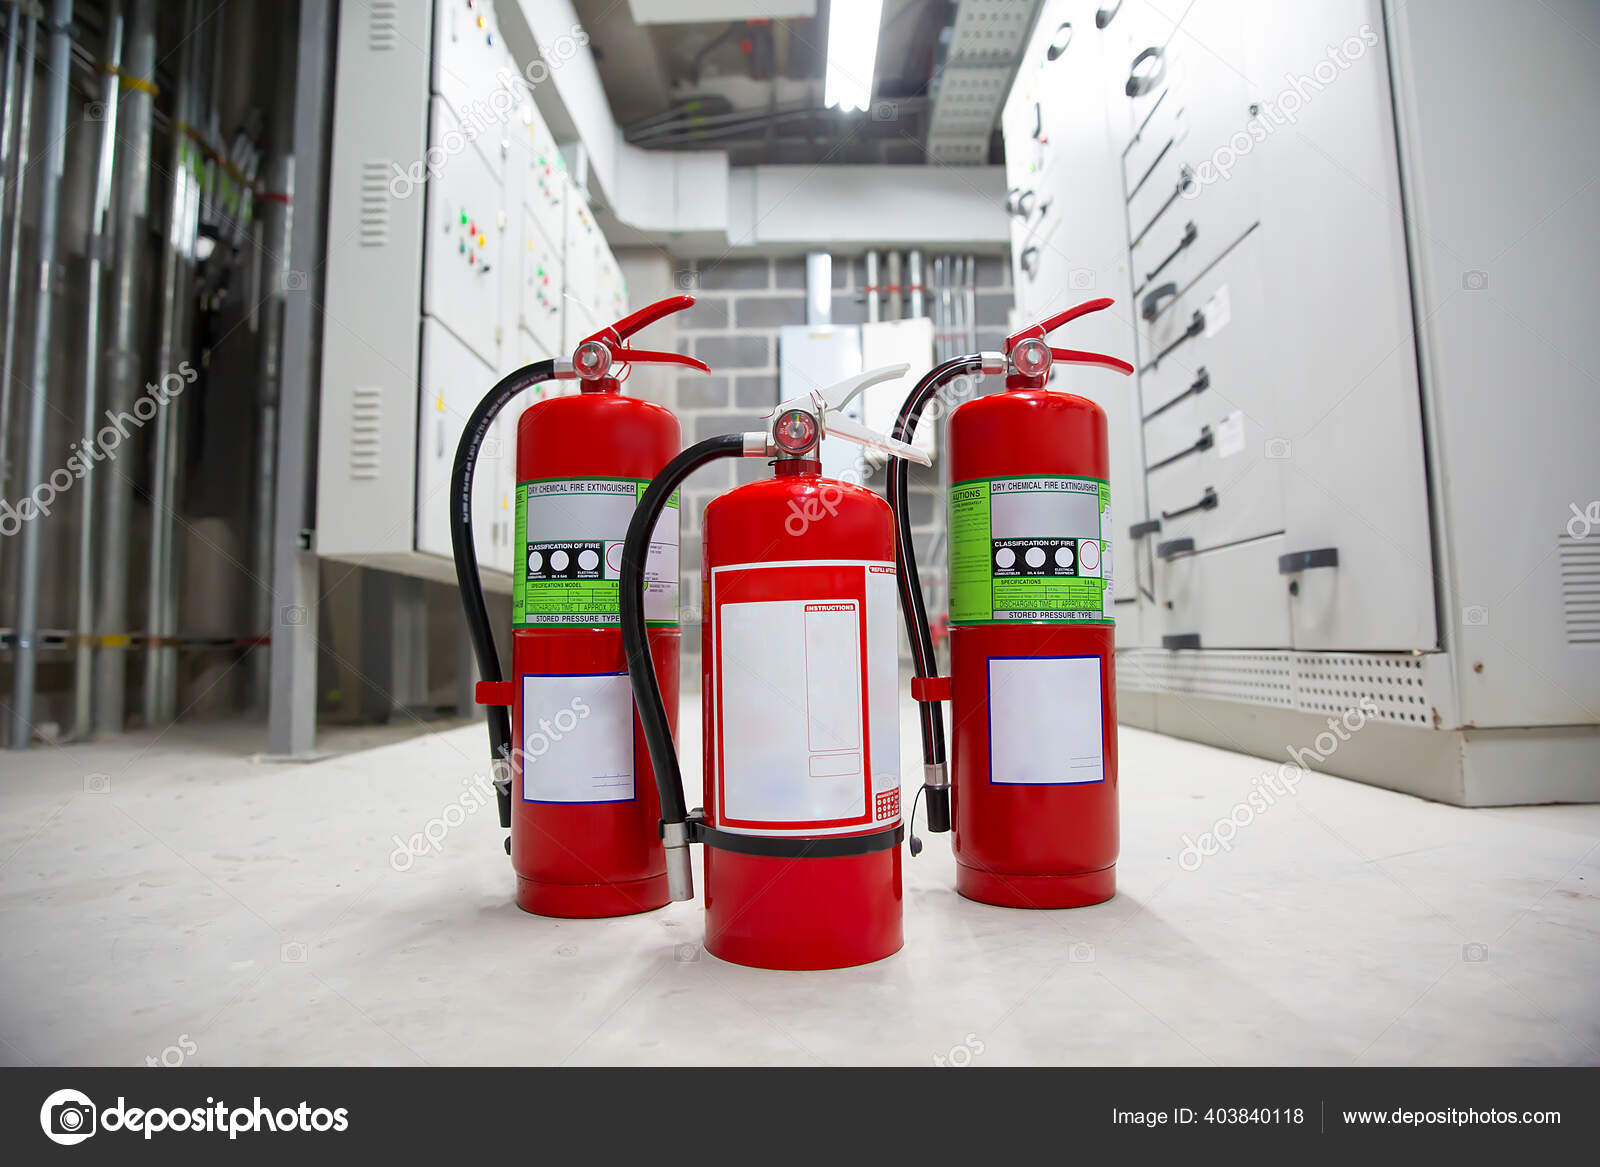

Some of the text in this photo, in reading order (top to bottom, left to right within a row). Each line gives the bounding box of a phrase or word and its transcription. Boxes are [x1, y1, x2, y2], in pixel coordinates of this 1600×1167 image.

[528, 486, 538, 495] DRY
[540, 484, 567, 494] CHEMICAL
[570, 483, 585, 491] FIRE
[587, 483, 635, 493] EXTINGUISHER
[992, 481, 1097, 492] DRY CHEMICAL FIRE EXTINGUISHER
[952, 489, 981, 500] AUTIONS
[527, 543, 573, 551] CLASSIFICATION
[806, 604, 854, 612] INSTRUCTIONS
[1000, 600, 1038, 608] DISCHARGING
